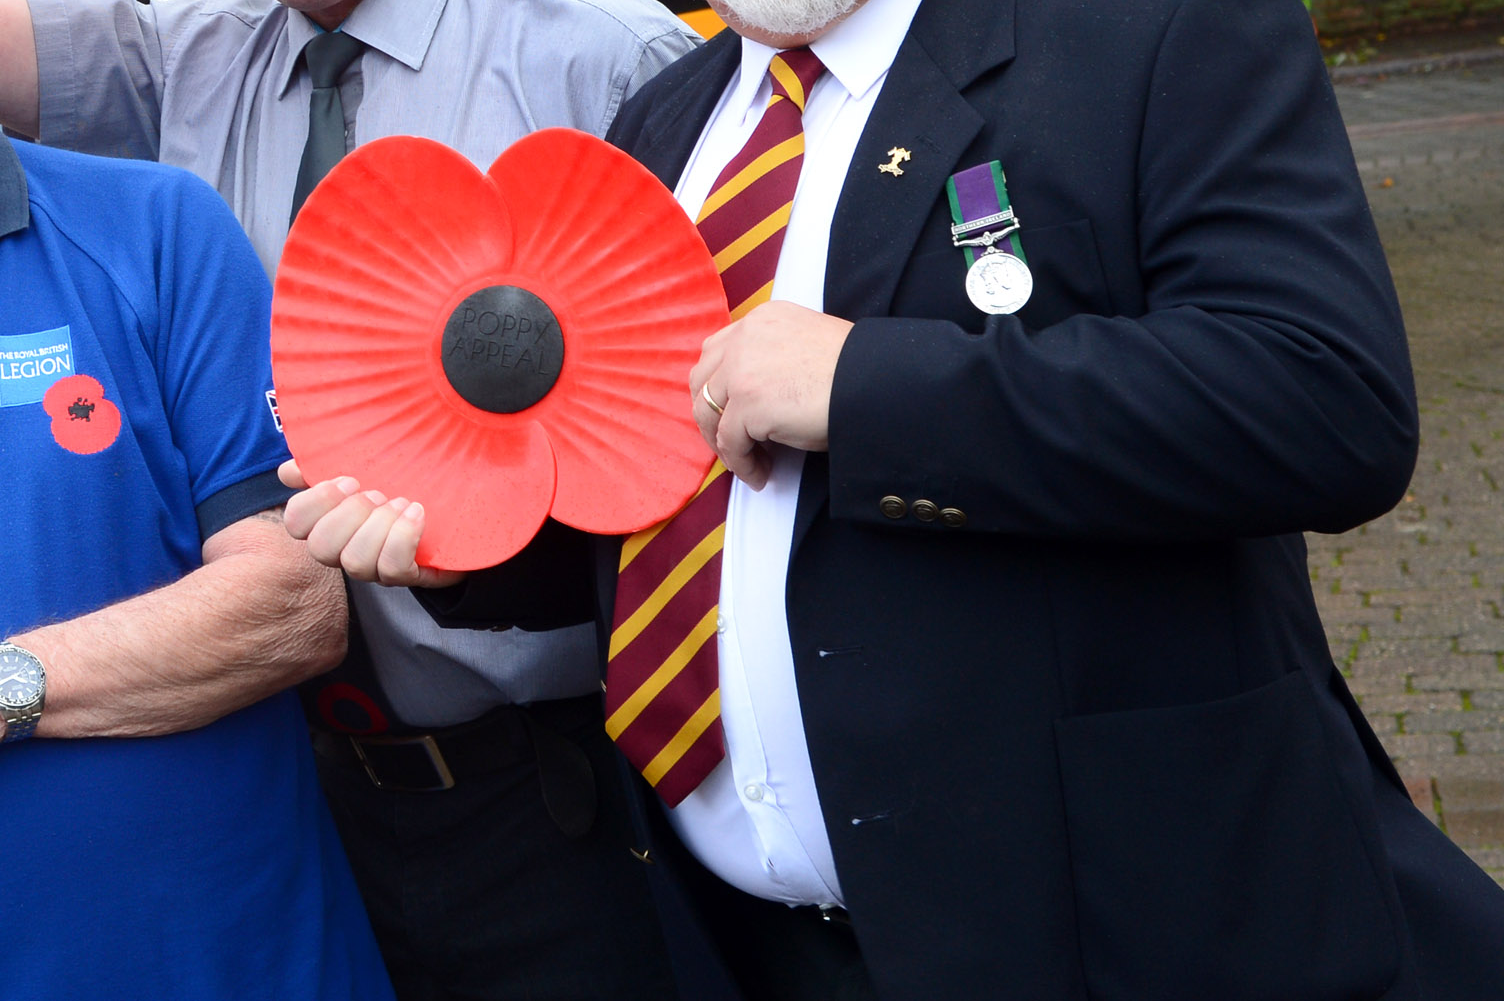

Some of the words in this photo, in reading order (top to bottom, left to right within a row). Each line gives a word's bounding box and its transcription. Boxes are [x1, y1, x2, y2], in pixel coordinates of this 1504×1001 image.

[461, 308, 552, 345] POPPY
[0, 354, 71, 379] LEGION
[14, 349, 40, 359] ROYAL
[39, 343, 69, 356] BRITISH
[448, 336, 549, 376] APPEAL
